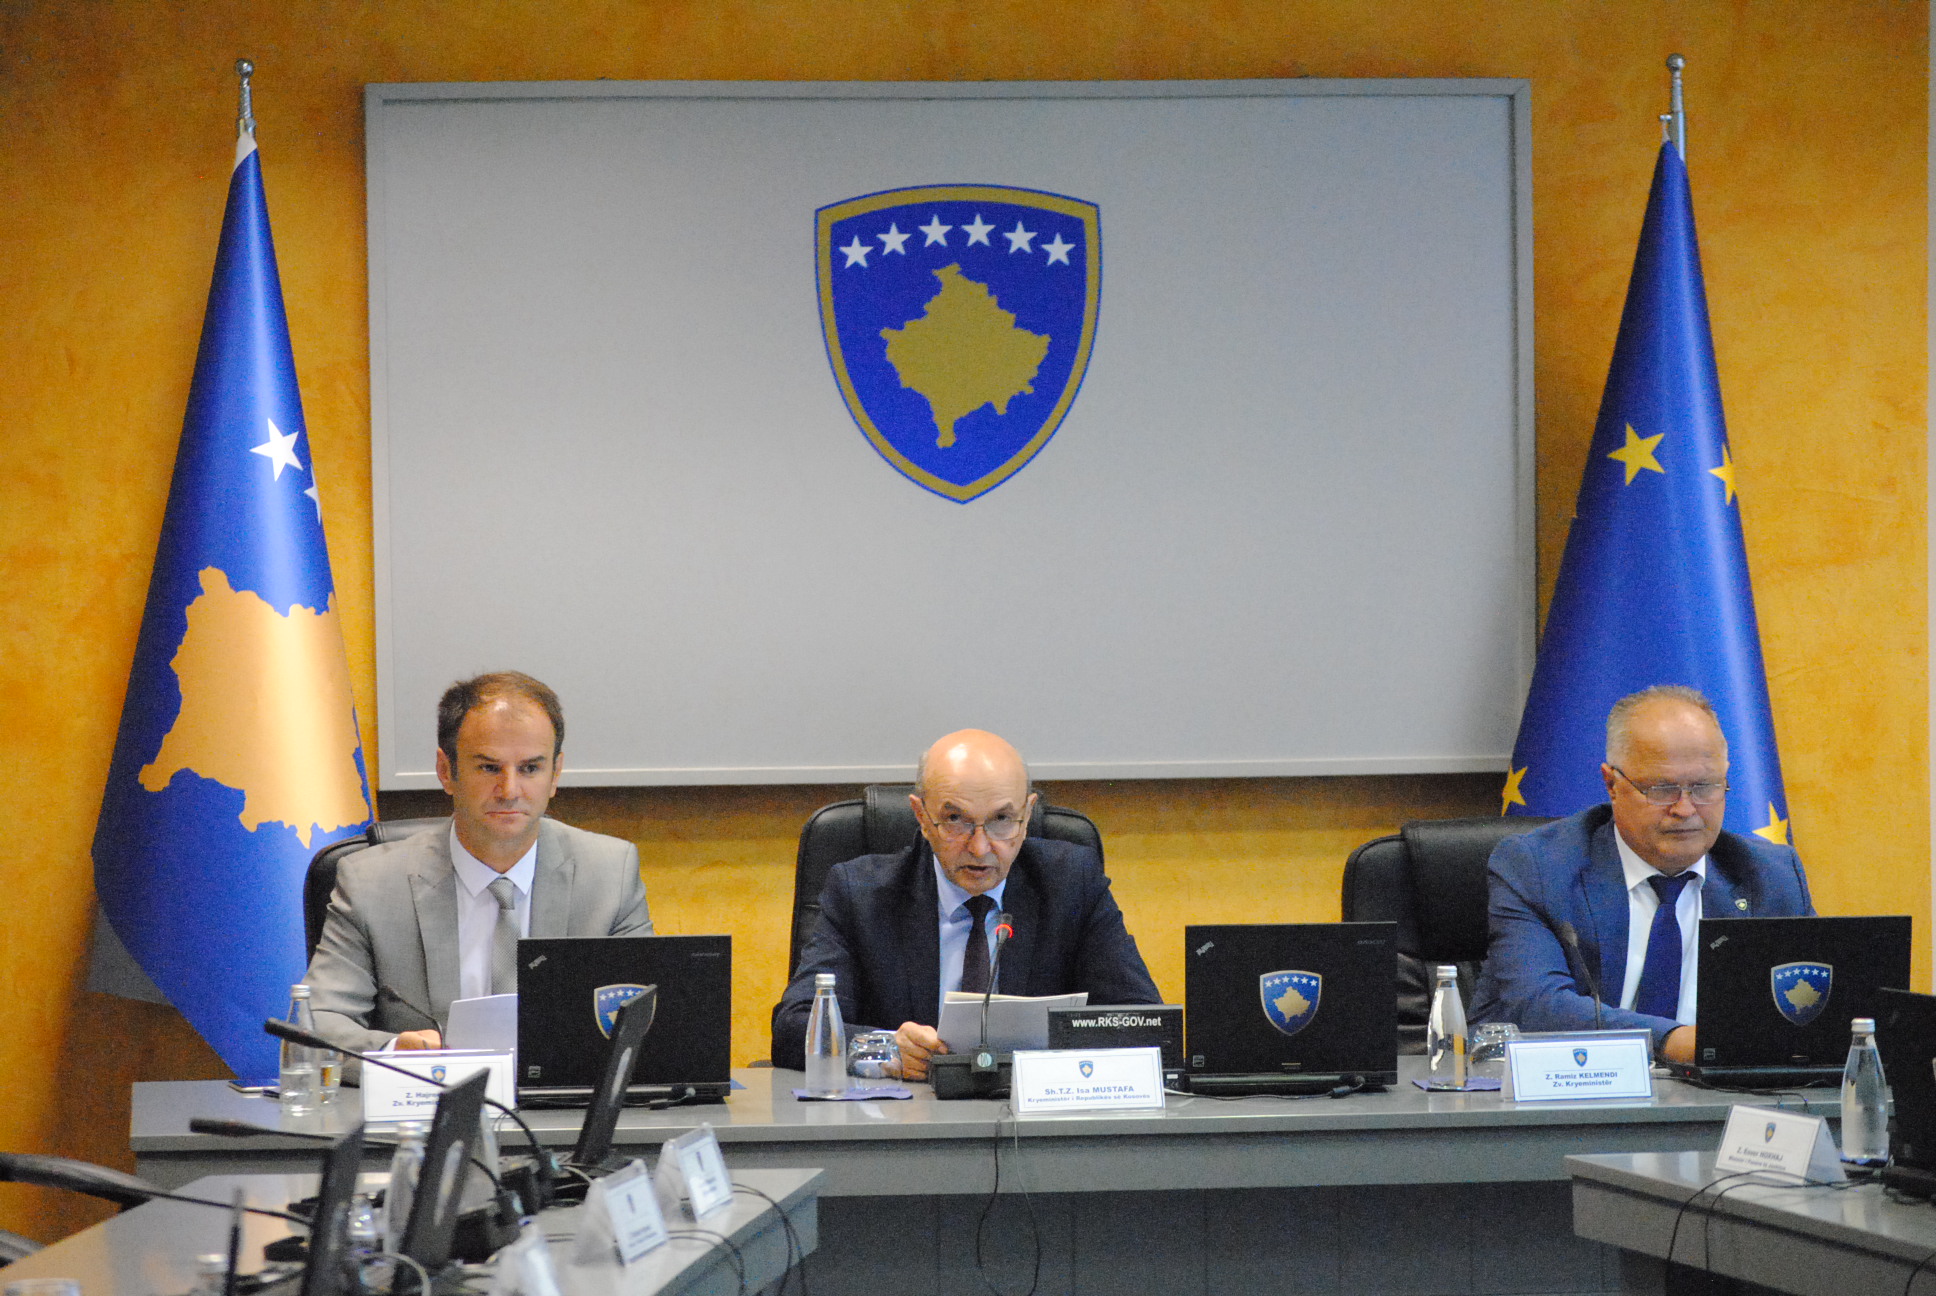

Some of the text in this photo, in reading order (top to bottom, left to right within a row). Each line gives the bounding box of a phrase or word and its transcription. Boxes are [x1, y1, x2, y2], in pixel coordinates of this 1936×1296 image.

[1072, 1016, 1161, 1027] www.RKS-GOV.net
[1045, 1087, 1074, 1095] Sh.T.Z.
[1077, 1086, 1090, 1094] Isa
